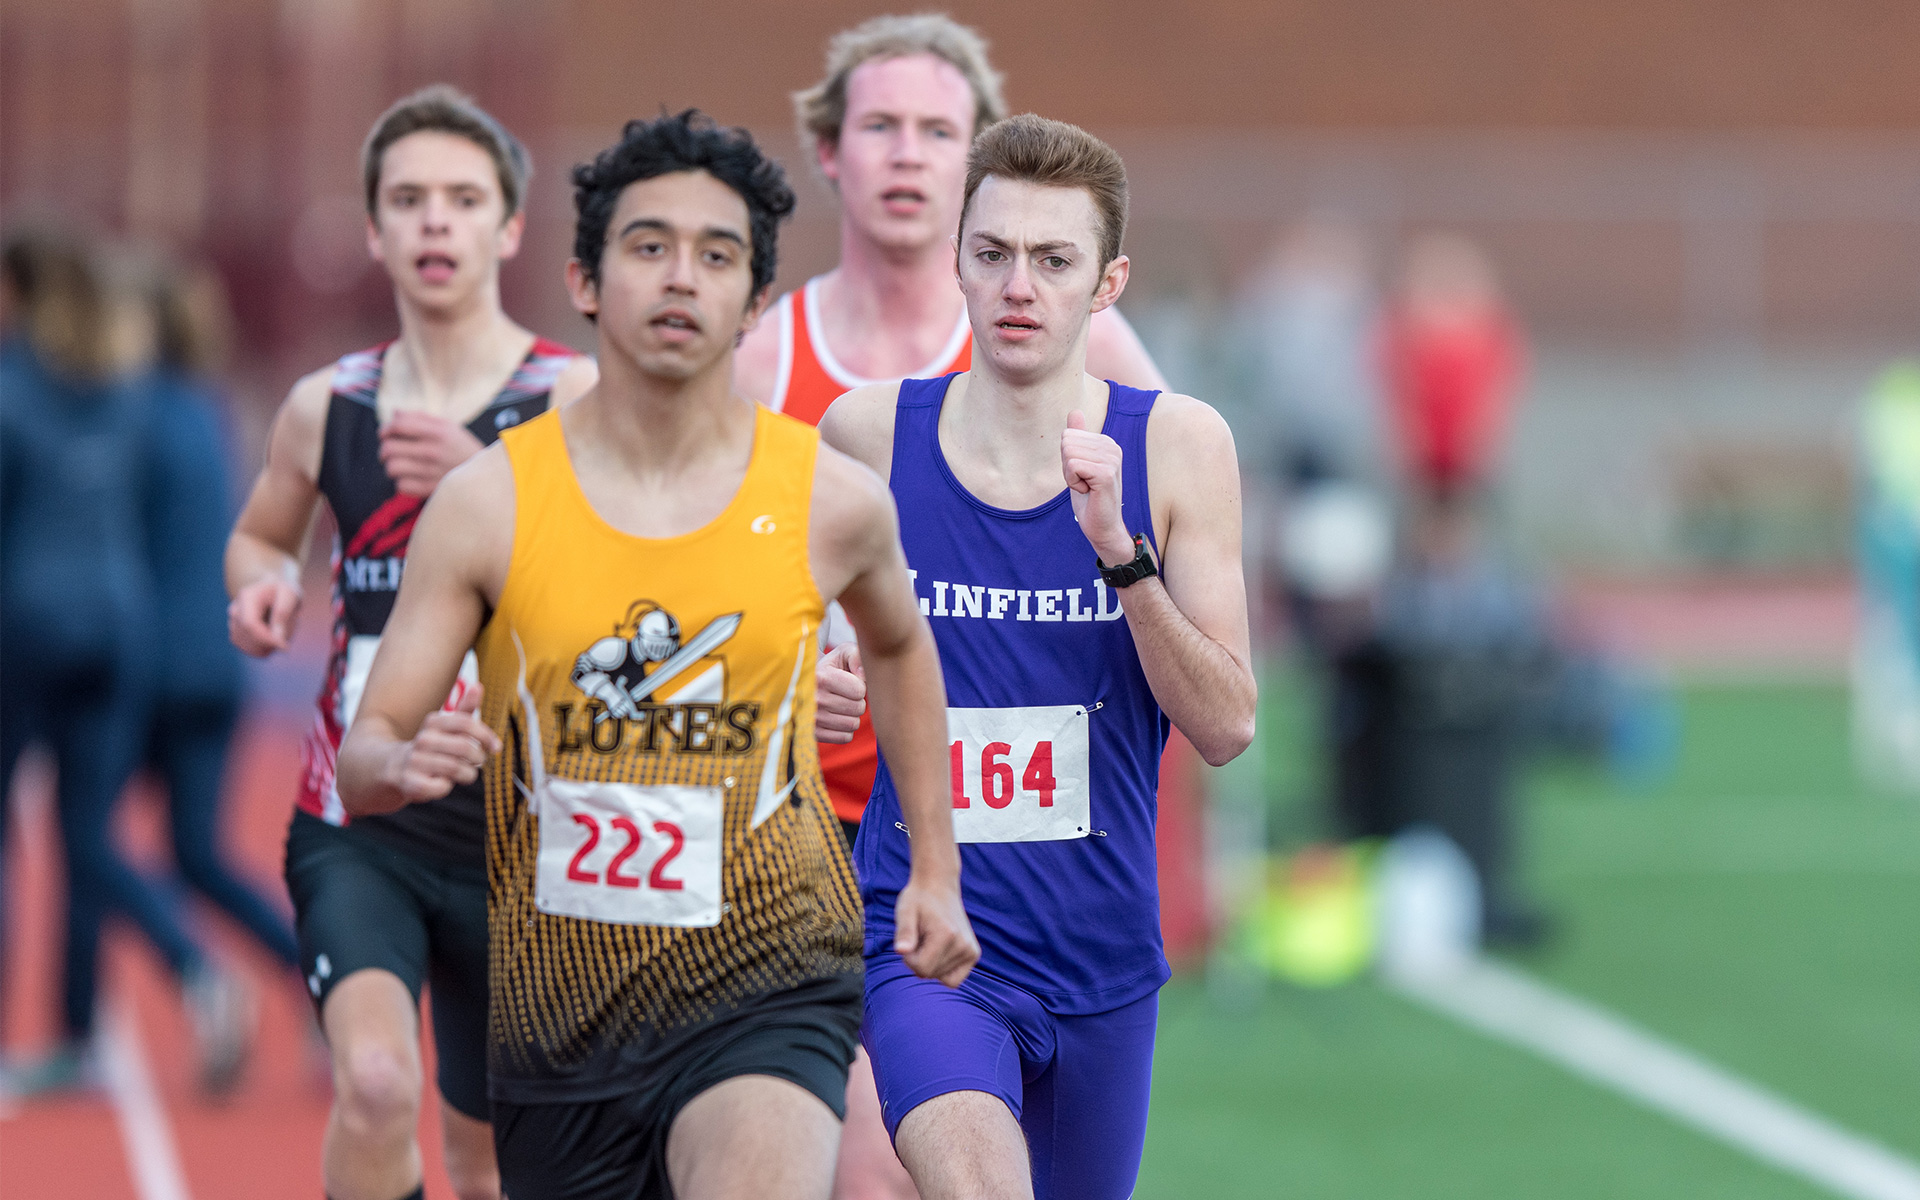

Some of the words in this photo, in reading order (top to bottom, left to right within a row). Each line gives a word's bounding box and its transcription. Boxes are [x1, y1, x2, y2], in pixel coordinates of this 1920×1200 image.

[554, 702, 761, 756] LUTES
[949, 740, 1056, 809] 164
[567, 813, 684, 890] 222
